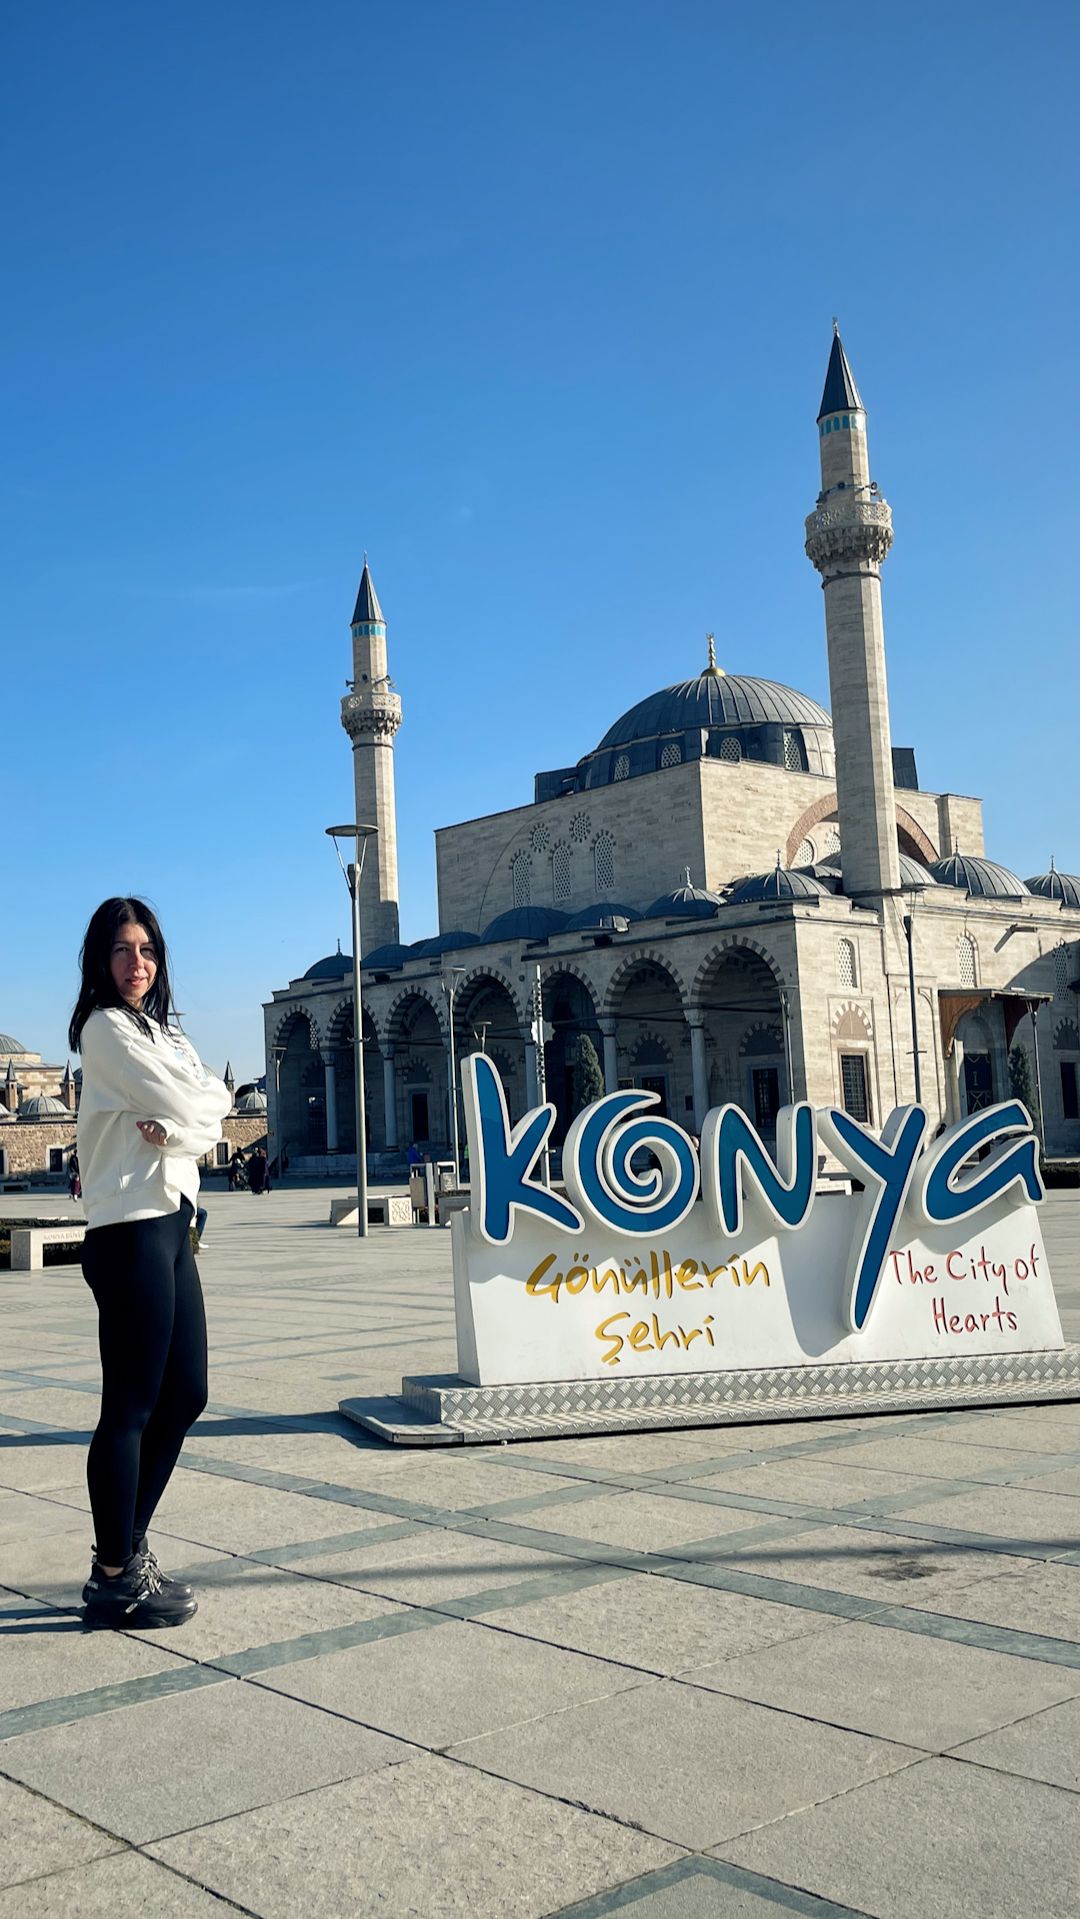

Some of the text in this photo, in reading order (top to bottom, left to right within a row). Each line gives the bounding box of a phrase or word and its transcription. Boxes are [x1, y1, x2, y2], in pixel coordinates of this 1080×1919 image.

[526, 1251, 770, 1302] Gönüllerin
[890, 1244, 1040, 1296] The City of
[594, 1312, 715, 1366] Şehri
[932, 1296, 1018, 1334] Hearts
